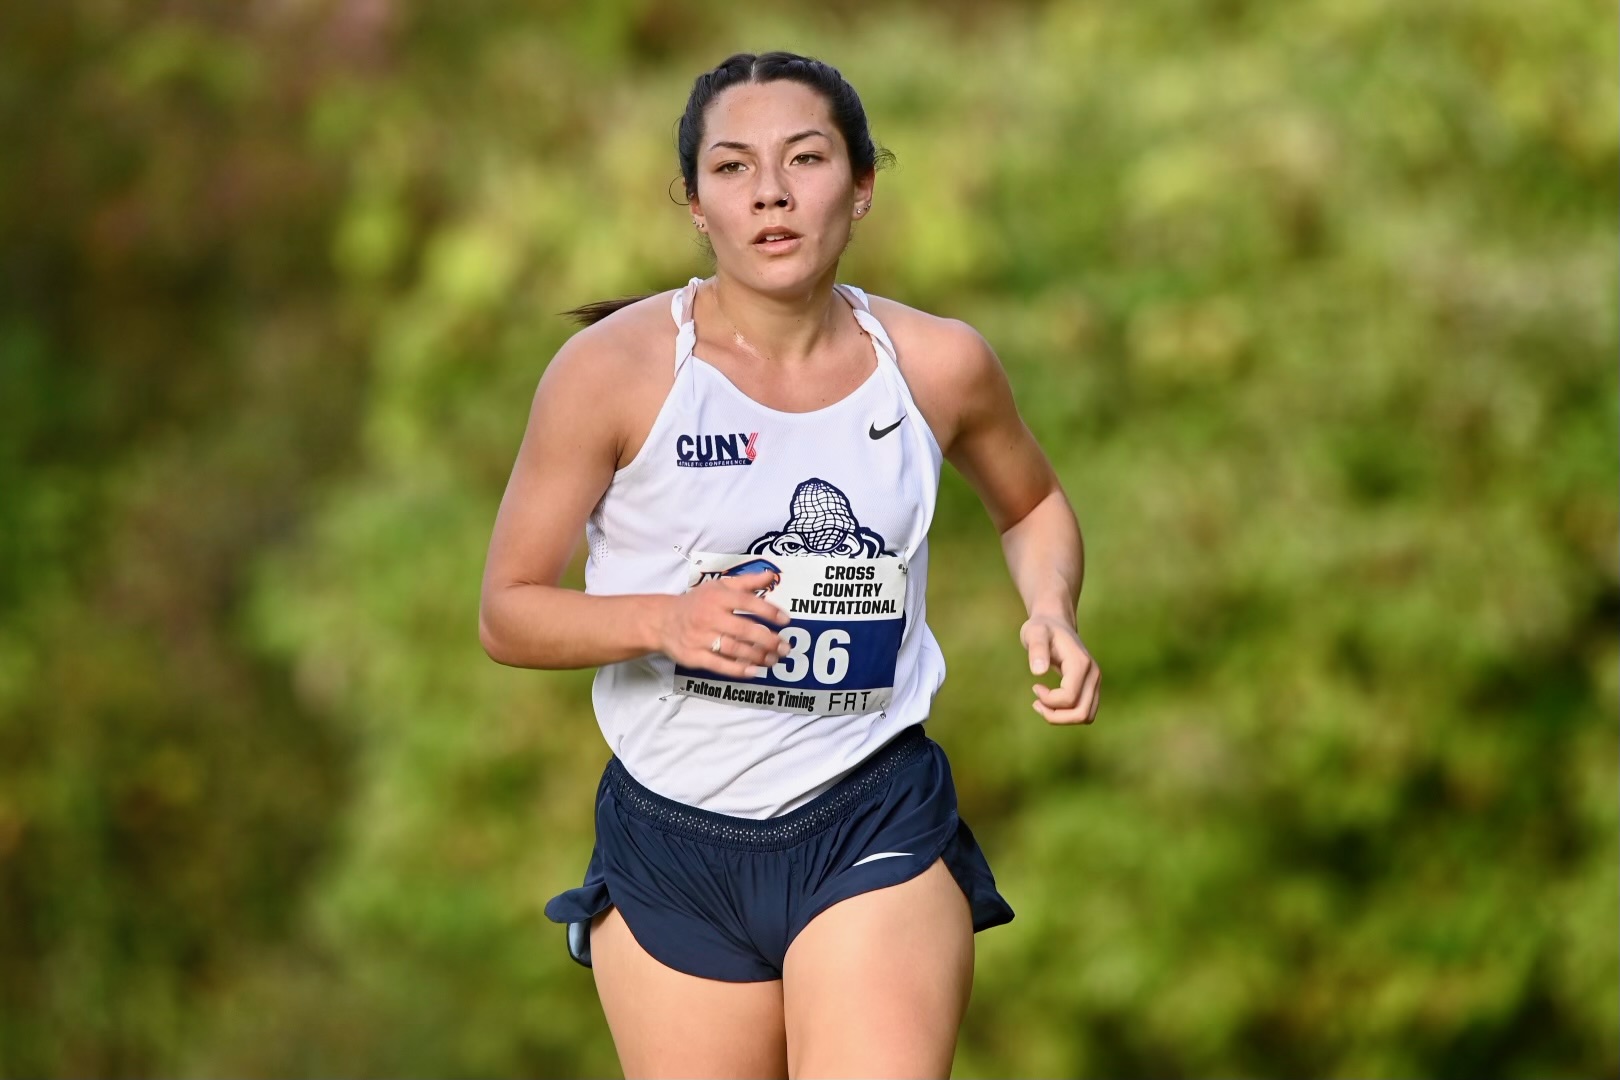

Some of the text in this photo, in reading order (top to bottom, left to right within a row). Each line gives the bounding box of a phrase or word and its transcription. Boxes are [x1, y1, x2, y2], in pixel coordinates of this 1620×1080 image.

[676, 432, 759, 461] CUNY
[825, 565, 875, 580] CROSS
[812, 583, 883, 597] COUNTRY
[789, 598, 897, 615] INVITATIONAL
[751, 624, 851, 685] 36
[685, 679, 872, 712] Fulton Accurate Timing FAT
